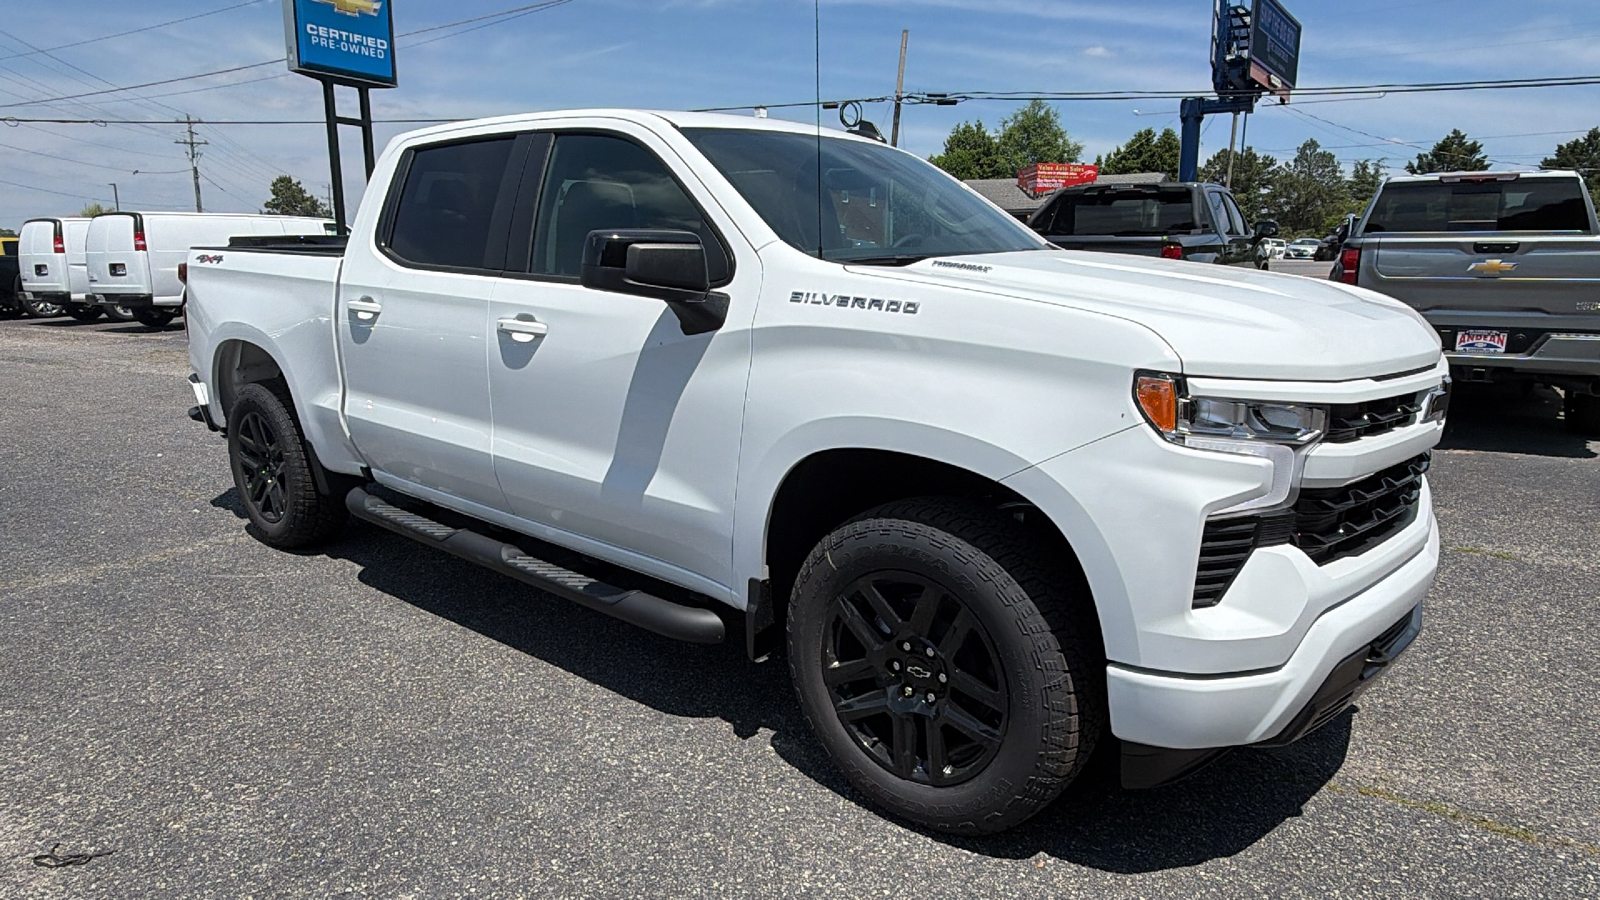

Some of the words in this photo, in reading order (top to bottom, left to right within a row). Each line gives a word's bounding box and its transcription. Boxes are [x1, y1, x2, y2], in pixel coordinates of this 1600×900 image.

[306, 23, 388, 50] CERTIFIED
[311, 35, 385, 59] PRE-OWNED
[789, 291, 921, 314] SILVERADO
[1458, 332, 1506, 347] ANDEAN
